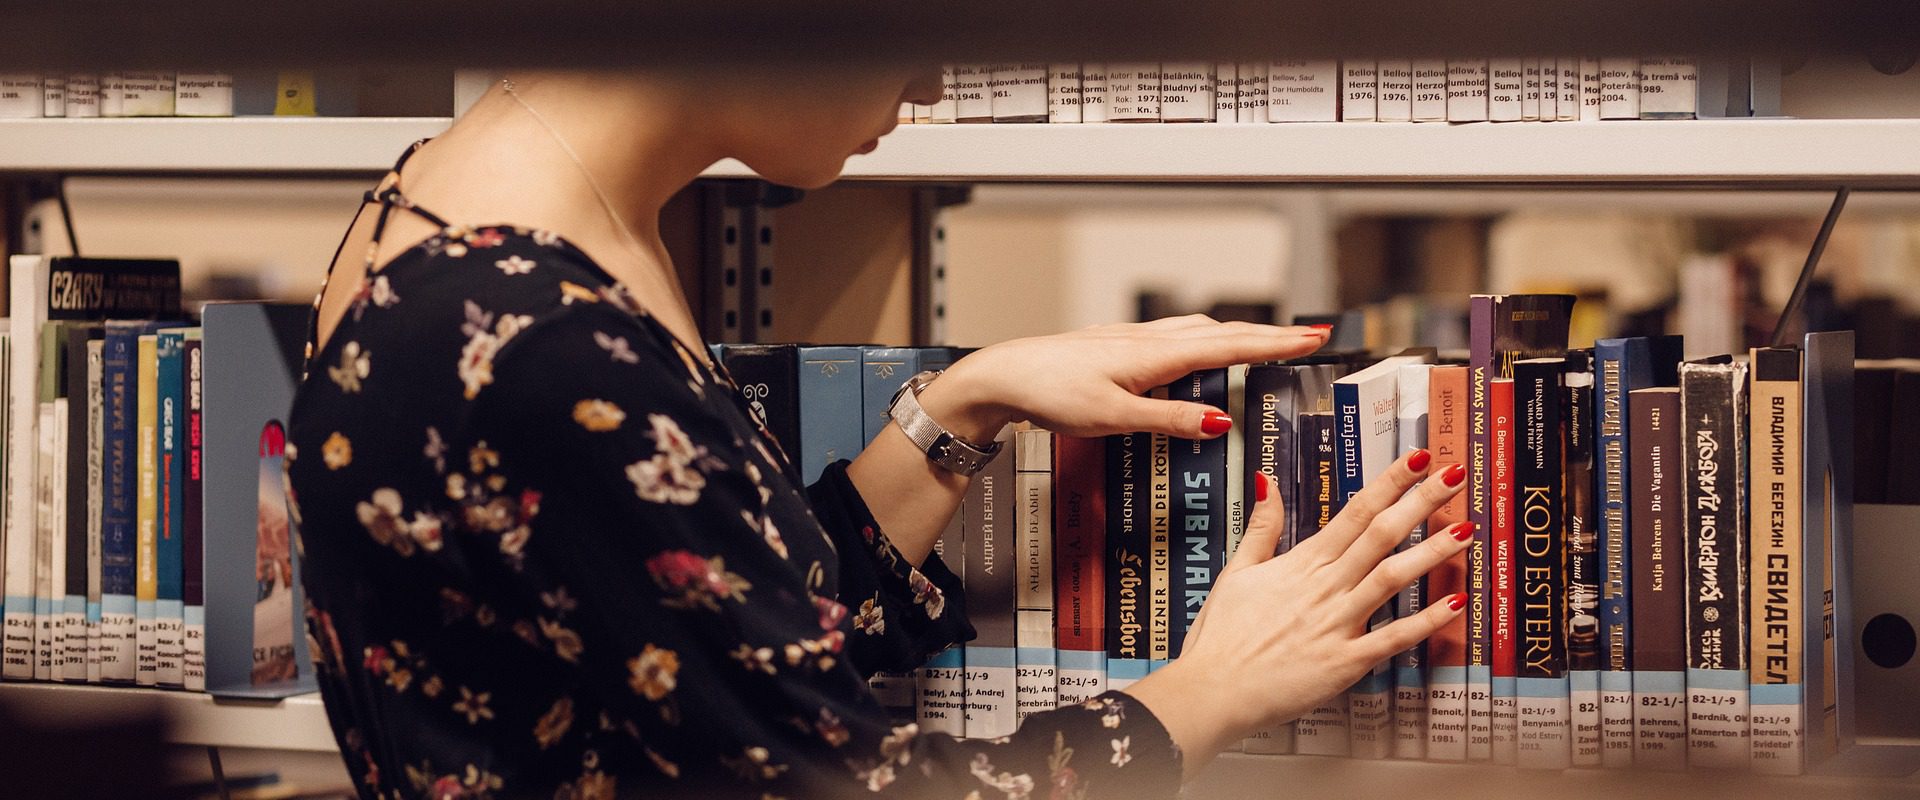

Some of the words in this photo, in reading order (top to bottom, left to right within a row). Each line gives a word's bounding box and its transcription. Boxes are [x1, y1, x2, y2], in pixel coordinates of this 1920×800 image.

[1272, 74, 1297, 82] Bellow,
[1602, 70, 1629, 78] Belov,
[1163, 84, 1197, 92] Bludnyj
[1494, 82, 1520, 90] Suma
[1350, 92, 1376, 100] 1976.
[1494, 94, 1513, 102] cop.
[1602, 94, 1627, 102] 2004.
[1113, 106, 1132, 114] Tom:
[1137, 106, 1152, 114] Kn.
[1473, 366, 1484, 408] ŚWIATA
[1536, 378, 1544, 420] BERNARD
[1572, 387, 1580, 404] idia
[1263, 394, 1280, 432] david
[1373, 398, 1395, 416] Walter
[1440, 390, 1454, 435] Benoit
[1474, 412, 1484, 434] PAN
[1497, 416, 1506, 428] G.
[1652, 408, 1660, 430] 14421
[1341, 404, 1358, 478] Benjamin
[1769, 396, 1784, 476] ВЛАДИМИР
[1319, 444, 1332, 453] 936
[1440, 442, 1454, 456] P.
[1536, 422, 1544, 468] BENYAMIN
[1496, 430, 1506, 479] Benusiglio,
[1124, 451, 1133, 478] ANN
[1320, 461, 1330, 474] VI
[1652, 446, 1662, 493] Vagantin
[1474, 442, 1484, 514] ANTYCHRYST
[1155, 482, 1166, 510] DER
[1319, 475, 1330, 502] Band
[1498, 482, 1506, 494] R.
[1124, 483, 1134, 534] BENDER
[1497, 496, 1506, 528] Agasso
[1652, 496, 1662, 512] Die
[1232, 501, 1242, 534] GŁĘBIA
[1524, 486, 1550, 558] KOD
[1771, 482, 1784, 548] БЕРЕЗИН
[1155, 516, 1166, 542] BIN
[1573, 515, 1583, 552] Zawód:
[1652, 518, 1662, 562] Behrens
[1155, 549, 1166, 571] ICH
[1474, 540, 1482, 589] BENSON
[1497, 540, 1507, 590] WZIĘŁAM
[1574, 555, 1582, 580] żona
[1652, 564, 1663, 592] Katja
[1155, 588, 1166, 652] BELZNER
[1473, 593, 1482, 638] HUGON
[1525, 566, 1552, 676] ESTERY
[1016, 669, 1054, 678] 82-1/-9
[1060, 678, 1098, 687] 82-1/-9
[924, 689, 948, 698] Belyj,
[976, 689, 1004, 698] Andrej
[1060, 694, 1082, 704] Belyj,
[1471, 692, 1488, 700] 82-
[1604, 696, 1630, 704] 82-1/
[1692, 694, 1736, 706] 82-1/-9
[924, 712, 948, 720] 1994.
[1432, 708, 1464, 717] Benoit,
[1522, 708, 1556, 716] 82-1/-9
[1692, 712, 1730, 722] Berdnik,
[1472, 724, 1488, 732] Pan
[1640, 718, 1680, 726] Behrens,
[1753, 716, 1790, 725] 82-1/-9
[1298, 728, 1318, 736] 1991
[1640, 730, 1656, 738] Die
[1691, 728, 1738, 737] Kamerton
[1753, 728, 1790, 738] Berezin,
